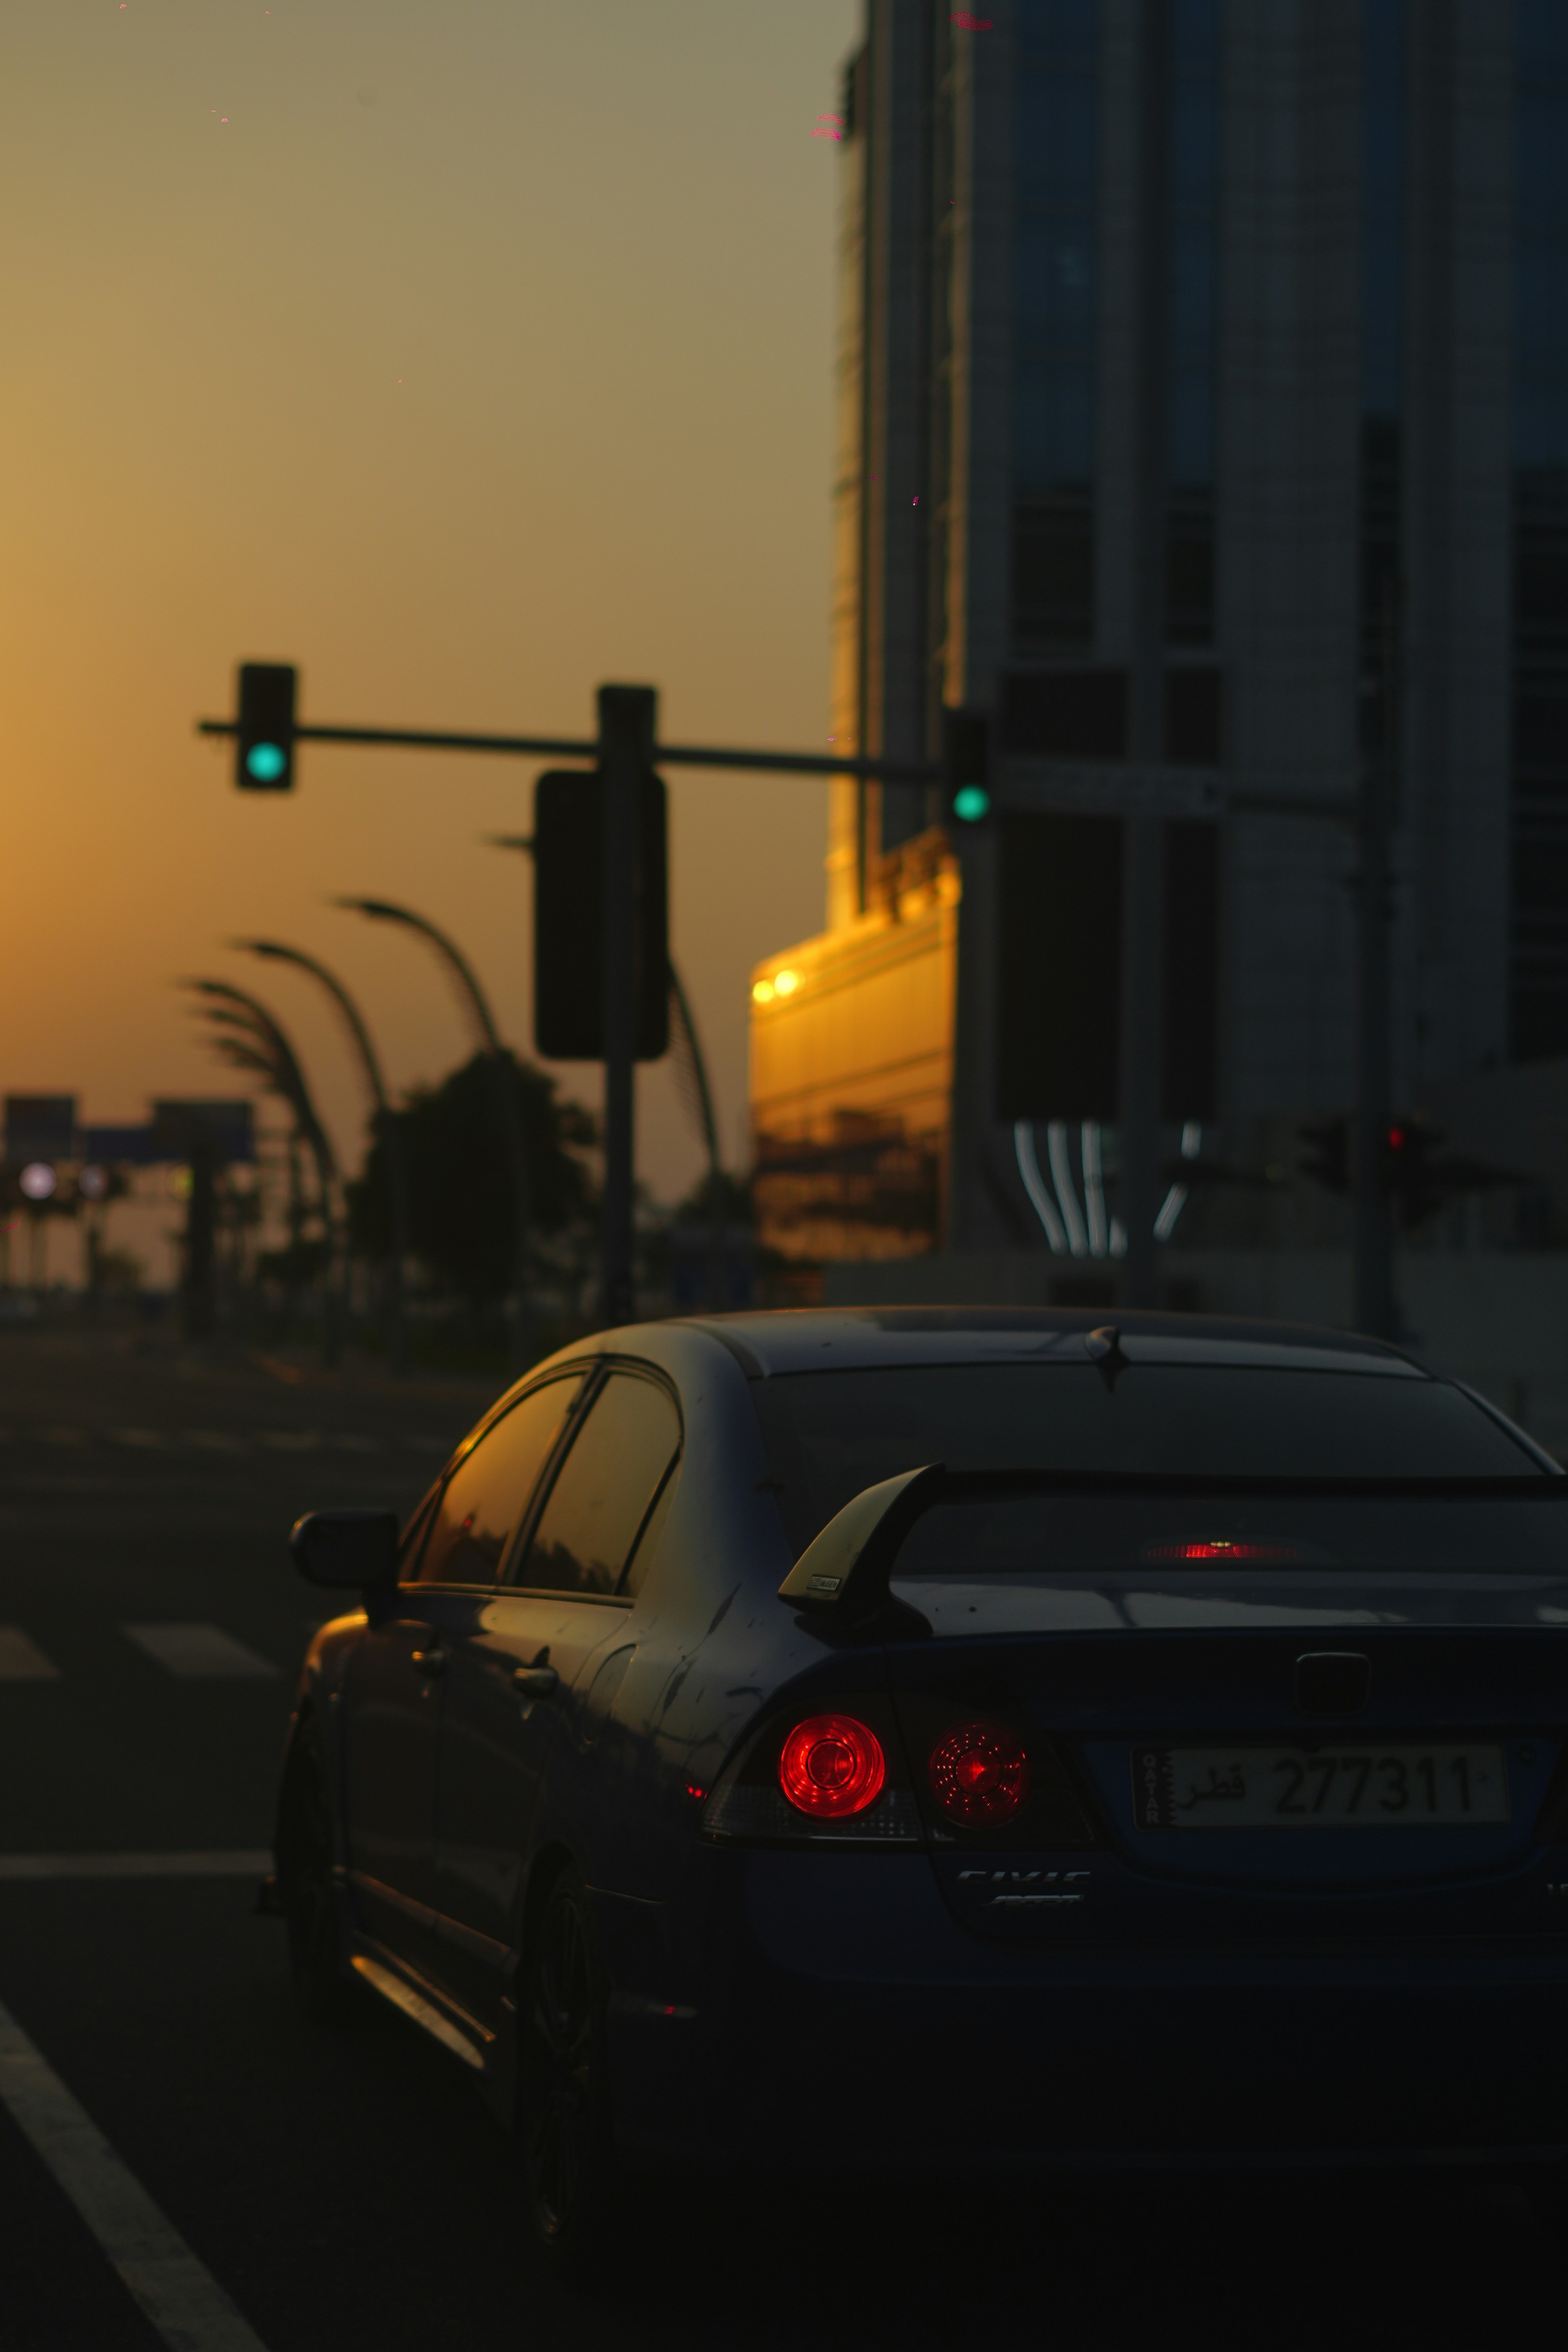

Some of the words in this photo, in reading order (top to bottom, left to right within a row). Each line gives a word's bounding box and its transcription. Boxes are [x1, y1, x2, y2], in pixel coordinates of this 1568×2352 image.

[1142, 1753, 1160, 1826] QATAR
[1176, 1764, 1246, 1810] قطر
[1273, 1755, 1472, 1815] 277311
[955, 1870, 1091, 1886] CIVIC
